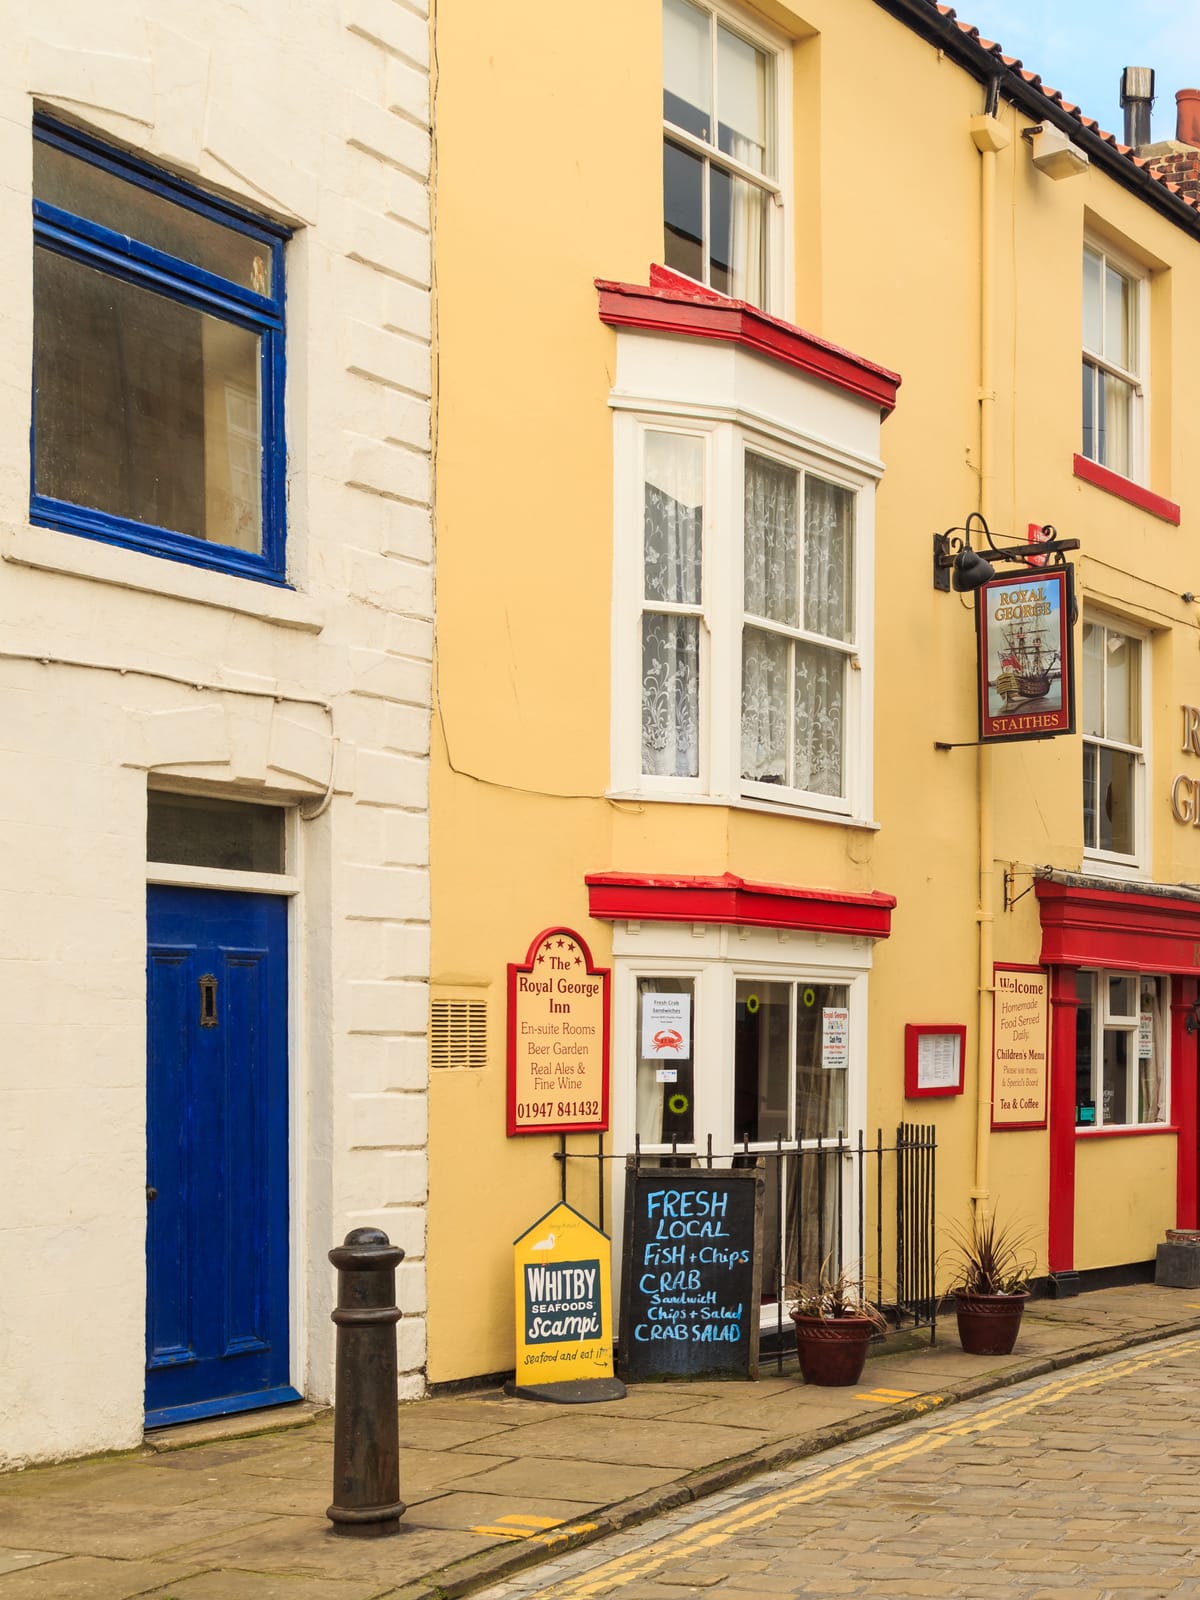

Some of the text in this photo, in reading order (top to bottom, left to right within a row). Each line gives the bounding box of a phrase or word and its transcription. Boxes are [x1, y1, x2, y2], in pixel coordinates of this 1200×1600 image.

[1000, 587, 1046, 606] ROYAL
[994, 602, 1052, 621] GEORGE
[992, 714, 1059, 732] STAITHES
[549, 956, 571, 970] The
[519, 976, 599, 998] Royal George
[999, 977, 1044, 995] Welcome
[549, 998, 571, 1013] Inn
[1001, 997, 1038, 1014] Homemade
[520, 1021, 596, 1035] En-suite Rooms
[1000, 1012, 1040, 1030] Food Served
[527, 1042, 589, 1055] Beer Garden
[996, 1048, 1045, 1060] Children's Menu
[530, 1061, 586, 1075] Real Ales &
[534, 1076, 583, 1090] Fine Wine
[517, 1100, 599, 1118] 01947 841432
[999, 1098, 1040, 1109] Tea & Coffee
[647, 1189, 728, 1219] FRESH
[655, 1218, 730, 1240] LOCAL
[689, 1252, 697, 1263] +
[699, 1246, 750, 1270] Chips
[527, 1267, 596, 1302] WHITBY
[639, 1269, 701, 1294] CRAB
[531, 1301, 593, 1314] SEAFOODS
[647, 1303, 743, 1324] Chips + Salad
[528, 1312, 599, 1342] Scampi
[634, 1323, 741, 1343] CRAB SALAD
[560, 1348, 577, 1361] and
[580, 1348, 594, 1360] eat
